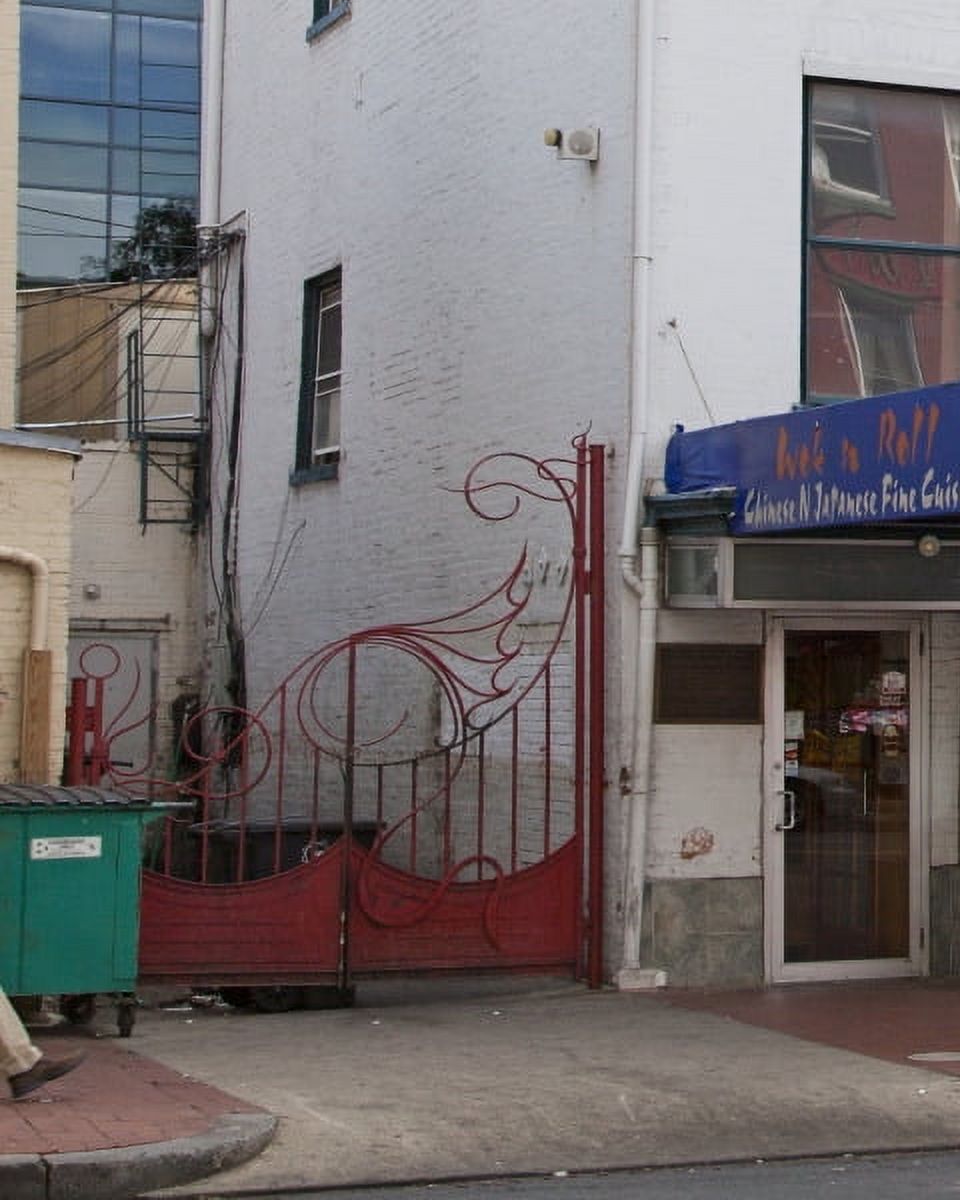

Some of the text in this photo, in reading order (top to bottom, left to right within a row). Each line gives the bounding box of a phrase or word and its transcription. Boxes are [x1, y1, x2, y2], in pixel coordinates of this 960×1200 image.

[877, 404, 941, 467] Roll
[744, 487, 797, 528] Chinese
[800, 482, 811, 523] N
[882, 471, 917, 513] Fine
